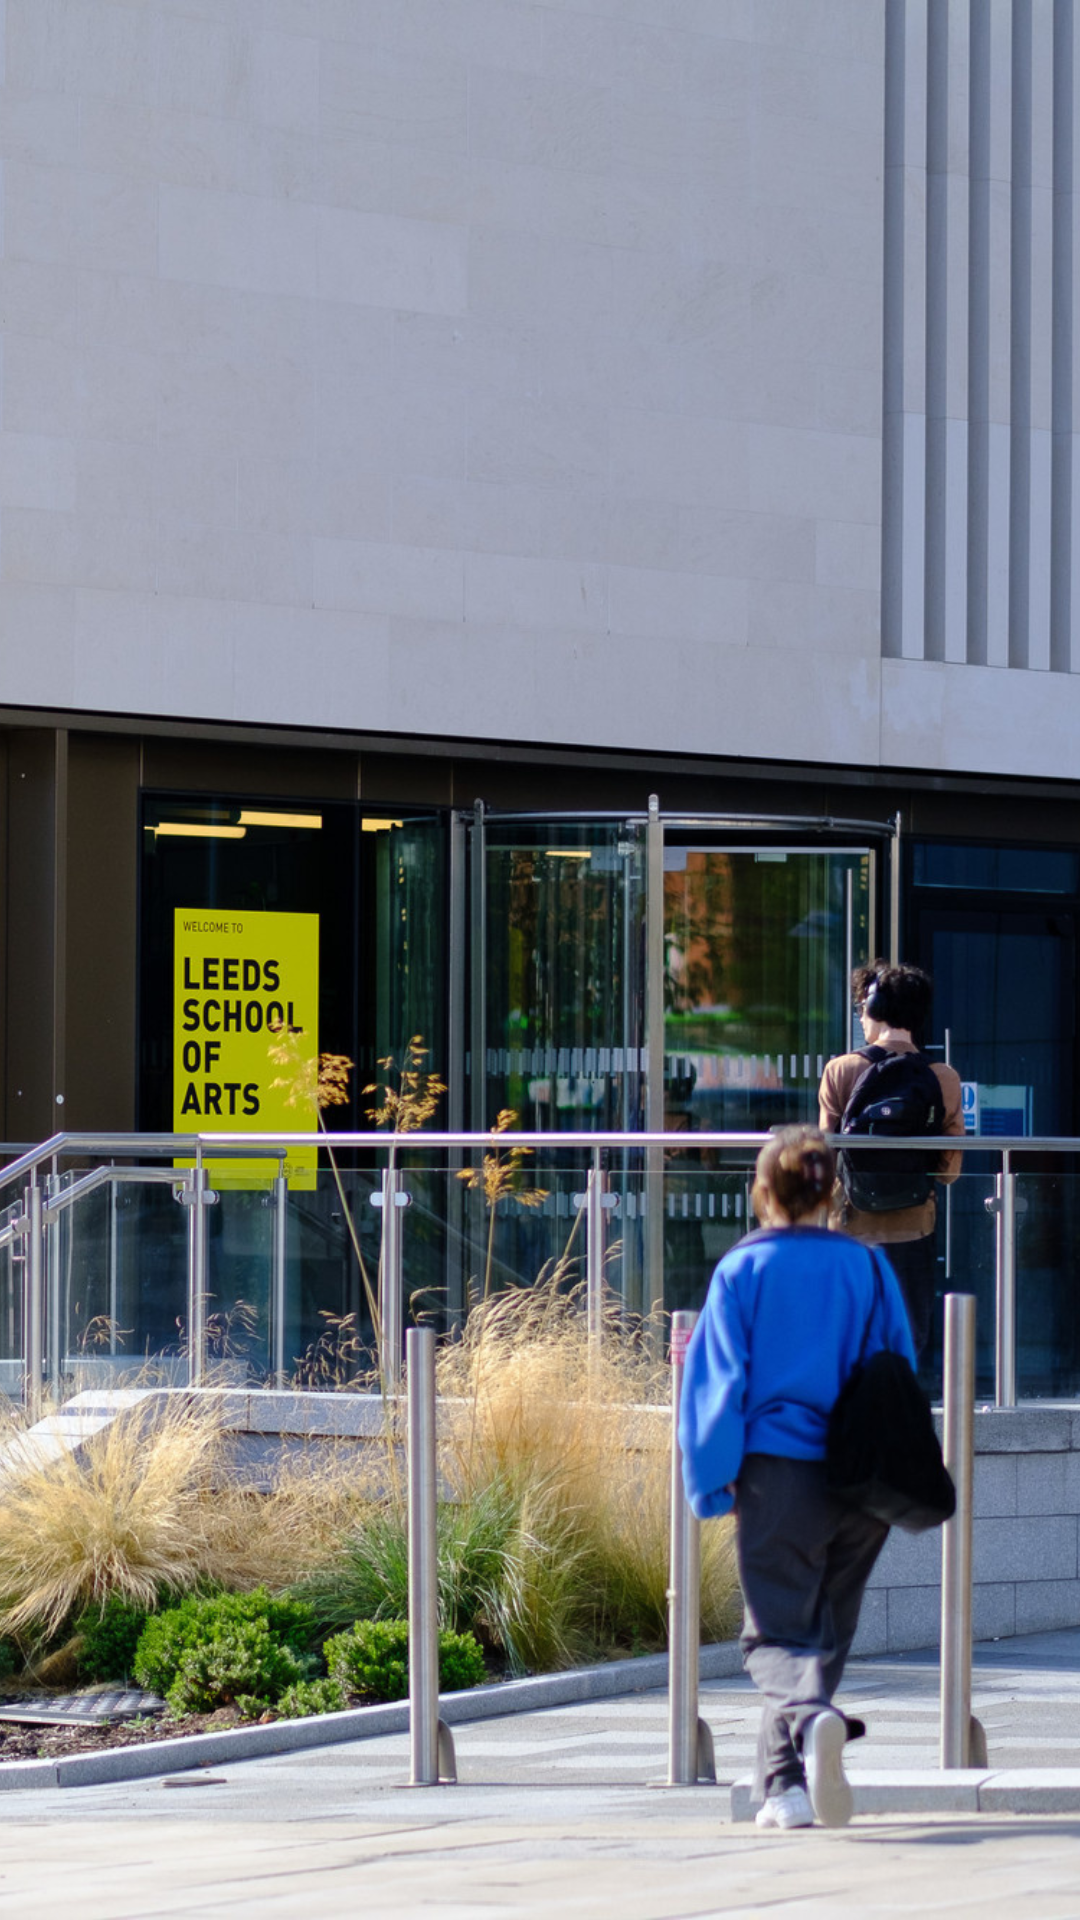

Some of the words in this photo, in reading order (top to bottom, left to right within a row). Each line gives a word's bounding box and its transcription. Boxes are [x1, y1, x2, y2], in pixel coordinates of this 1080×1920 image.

[183, 921, 228, 933] WELCOME
[232, 923, 243, 933] TO
[184, 957, 280, 992] LEEDS
[182, 998, 303, 1033] SCHOOL
[183, 1040, 221, 1073] OF
[181, 1082, 260, 1115] ARTS
